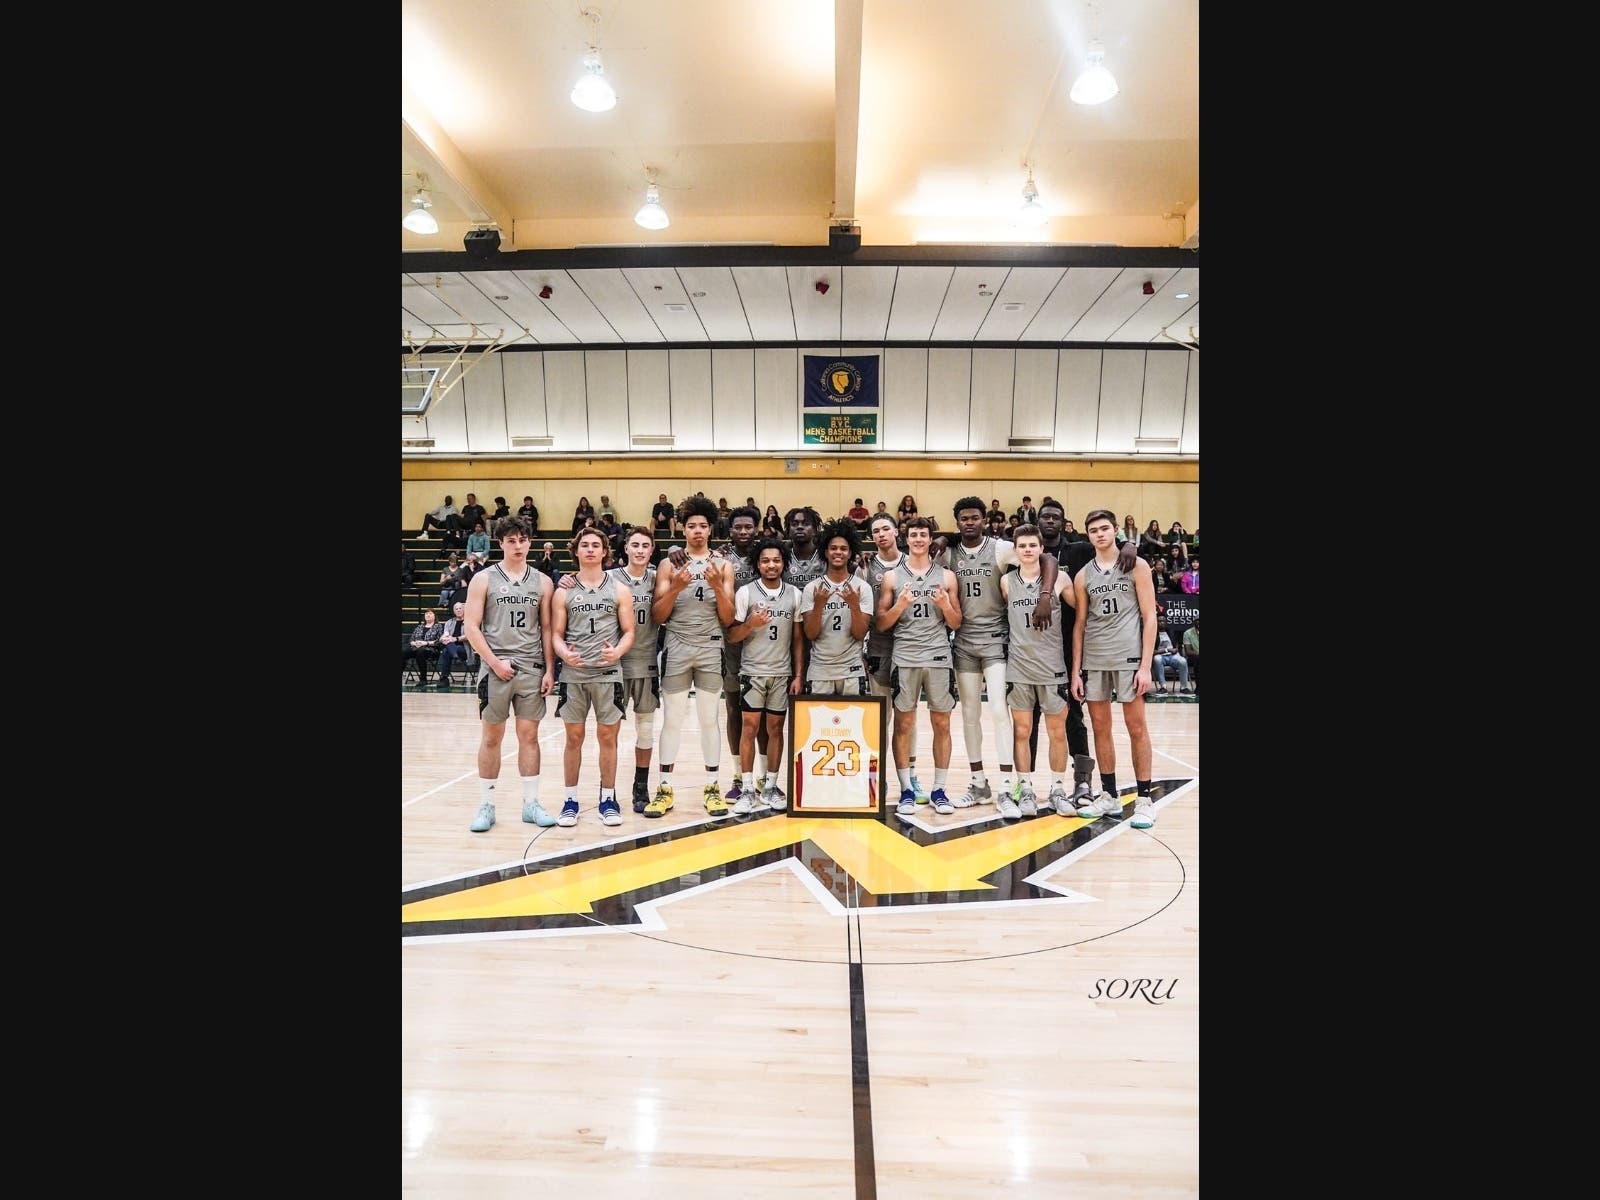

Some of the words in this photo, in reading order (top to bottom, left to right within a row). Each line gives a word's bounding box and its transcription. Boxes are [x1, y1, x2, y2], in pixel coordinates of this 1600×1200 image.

[828, 394, 854, 403] ATHLETICS
[805, 427, 826, 436] MEN'S
[828, 428, 875, 436] BASKETBALL
[820, 435, 863, 443] CHAMPIONS
[956, 568, 992, 577] PROLIFIC
[695, 586, 704, 601] 4
[966, 581, 982, 598] 15
[1089, 583, 1129, 595] PROLIFIC
[496, 595, 538, 607] PROLIFIC
[1102, 598, 1119, 615] 31
[1166, 600, 1187, 609] THE
[571, 603, 614, 615] PROLIFIC
[913, 603, 930, 618] 21
[1166, 608, 1199, 617] GRIND
[509, 611, 526, 628] 12
[589, 618, 596, 634] 1
[832, 615, 842, 631] 2
[769, 625, 778, 641] 3
[811, 739, 861, 777] 23
